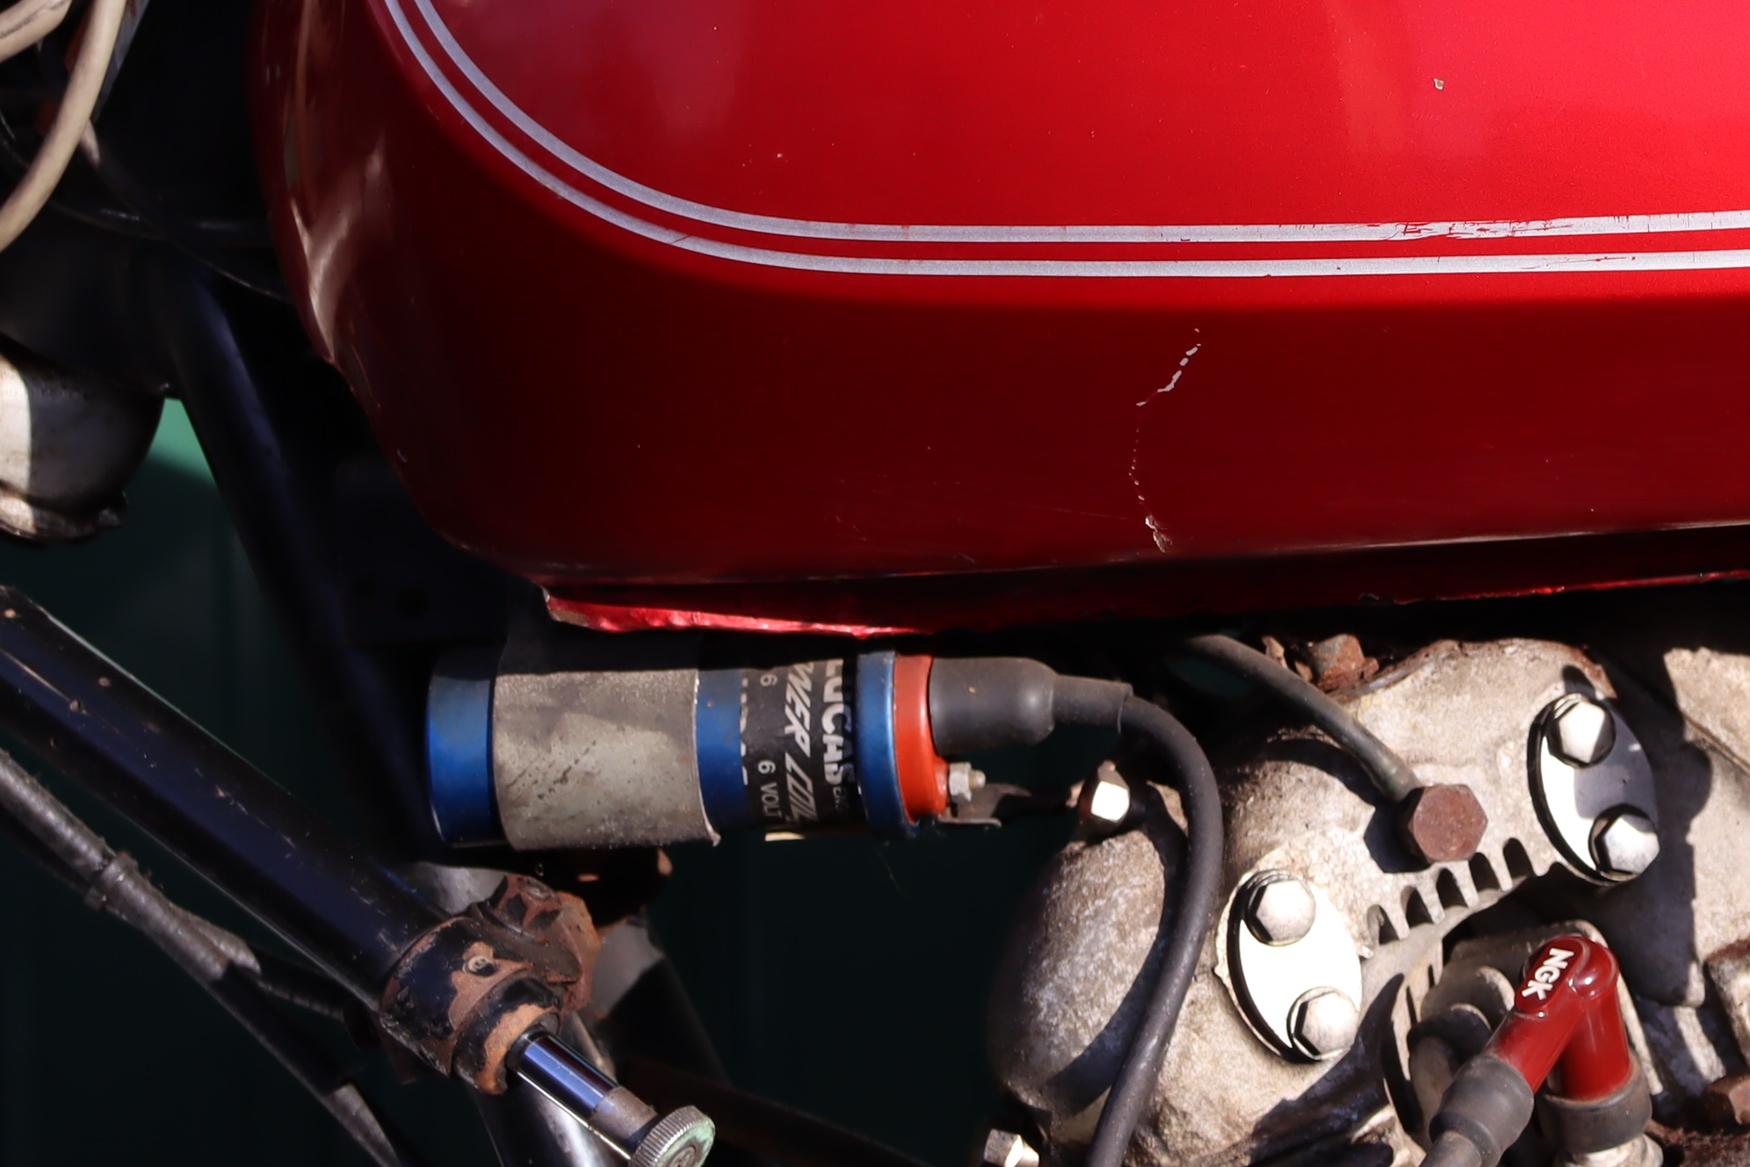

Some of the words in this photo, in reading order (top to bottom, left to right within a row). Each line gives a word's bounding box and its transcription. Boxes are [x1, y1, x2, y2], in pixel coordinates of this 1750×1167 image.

[822, 659, 855, 785] LUCAS
[758, 760, 776, 774] 6
[760, 782, 783, 818] VOLT
[1521, 947, 1575, 1001] NGK
